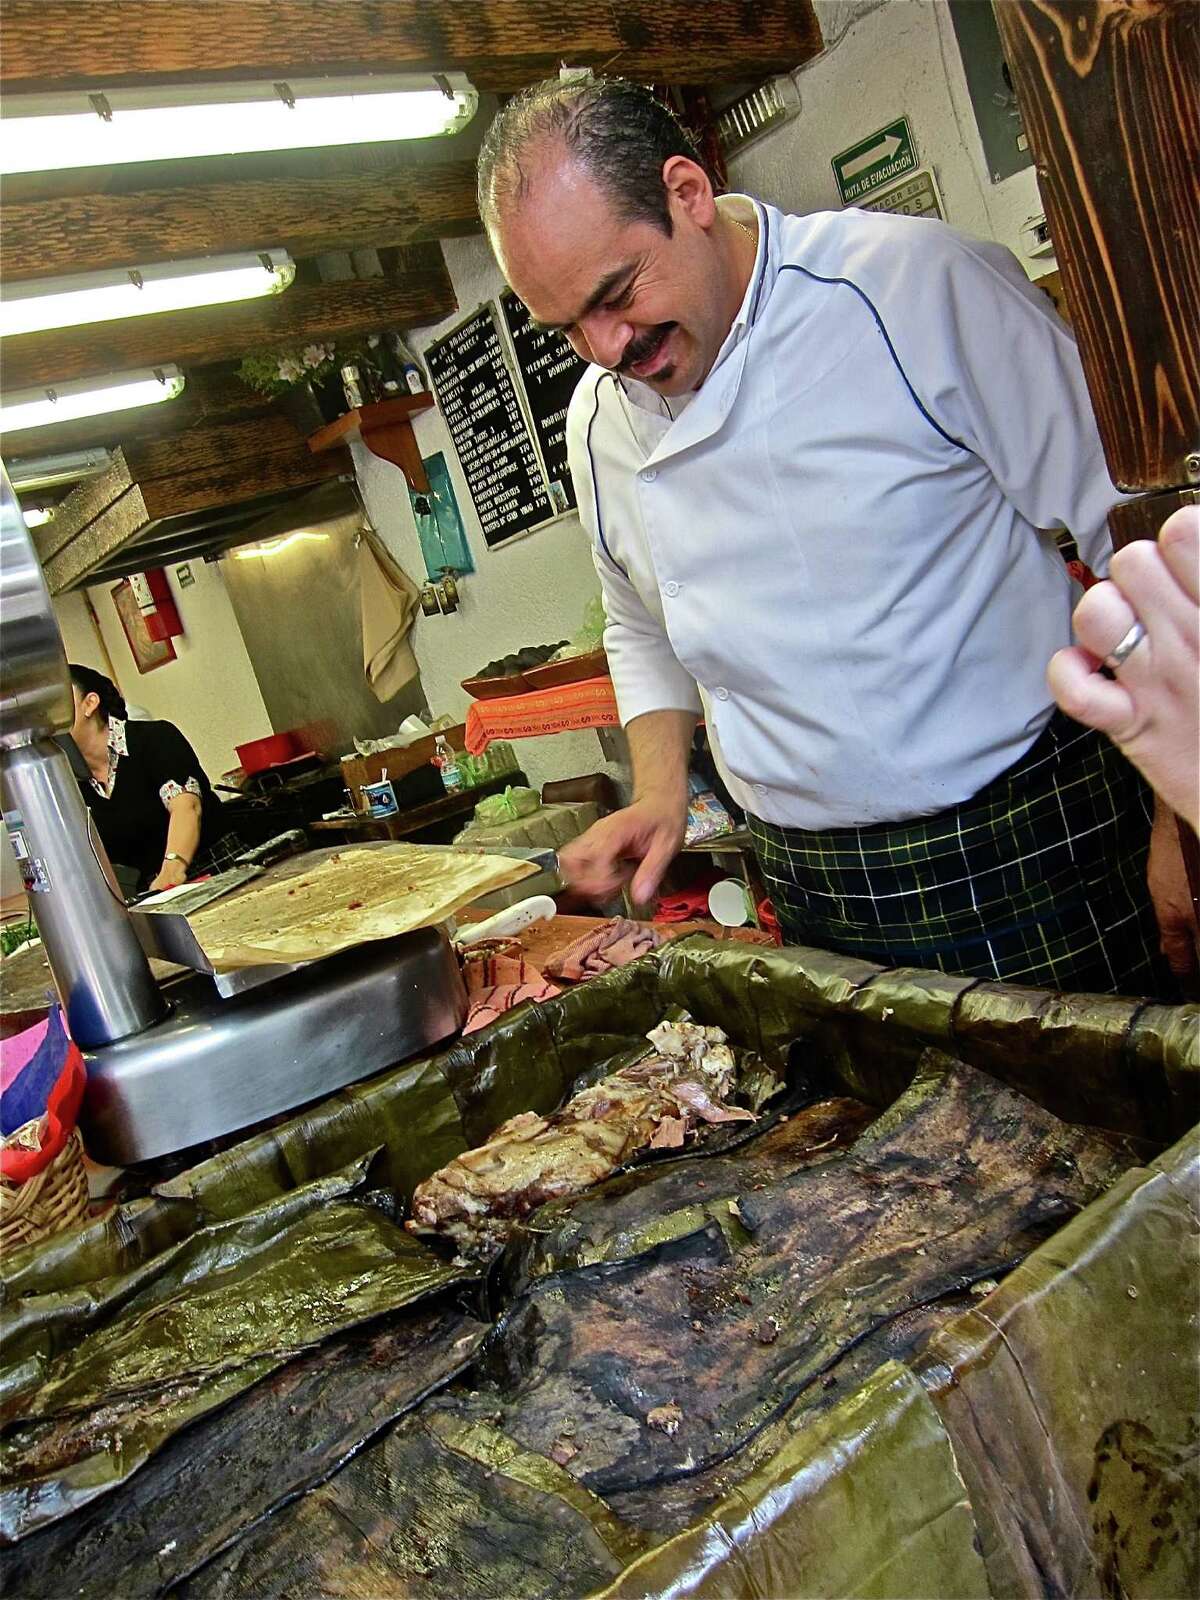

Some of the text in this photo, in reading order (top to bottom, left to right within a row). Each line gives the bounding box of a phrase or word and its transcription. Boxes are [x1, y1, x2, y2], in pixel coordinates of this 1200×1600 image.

[844, 186, 861, 199] RUTA
[862, 177, 870, 191] DE
[548, 354, 578, 378] DOMINGOS
